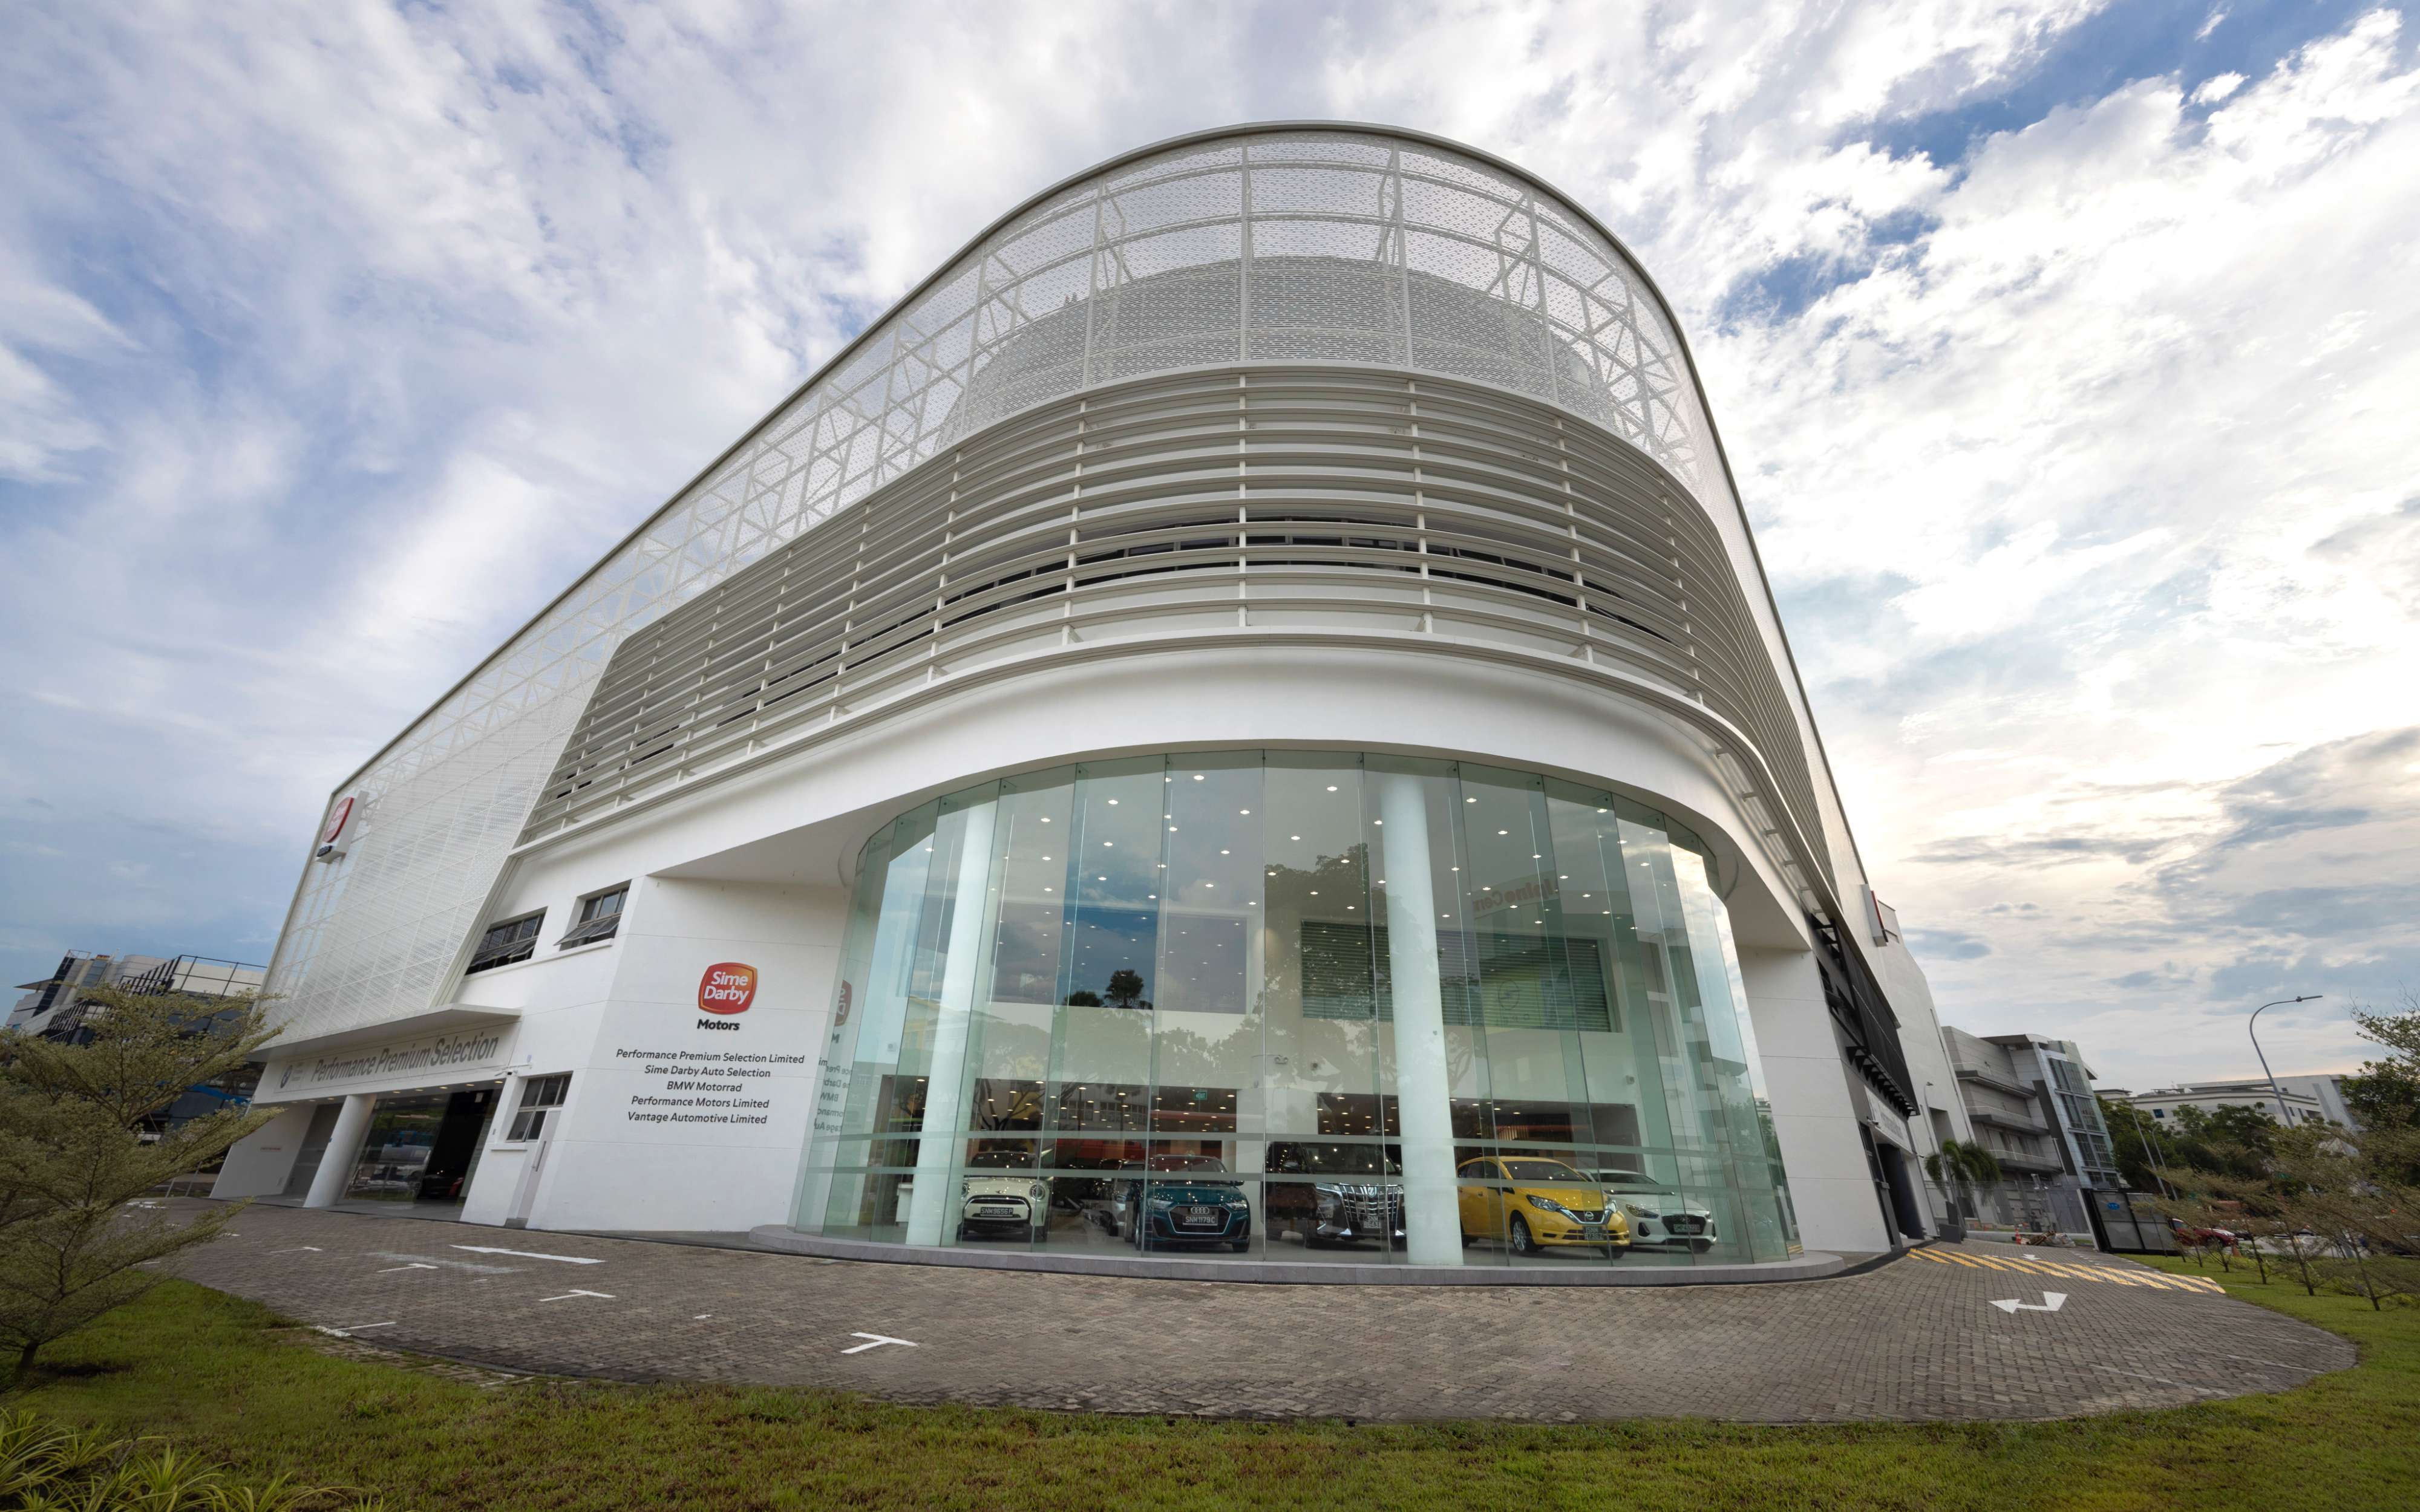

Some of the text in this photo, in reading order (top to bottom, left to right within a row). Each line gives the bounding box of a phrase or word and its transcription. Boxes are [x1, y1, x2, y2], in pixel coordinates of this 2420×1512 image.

[711, 971, 748, 985] Sime
[704, 985, 749, 1005] Darby
[697, 1018, 740, 1031] Motors
[310, 1057, 376, 1082] Performance
[374, 1043, 431, 1074] Premium
[430, 1032, 499, 1066] Selection
[616, 1049, 805, 1064] Performance Premium Selection Limited
[644, 1064, 771, 1077] Sime Darby Auto Selection
[667, 1081, 742, 1092] BMW Motorrad
[632, 1095, 770, 1108] Performance Motors Limited
[628, 1112, 768, 1124] Vantage Automotive Limited
